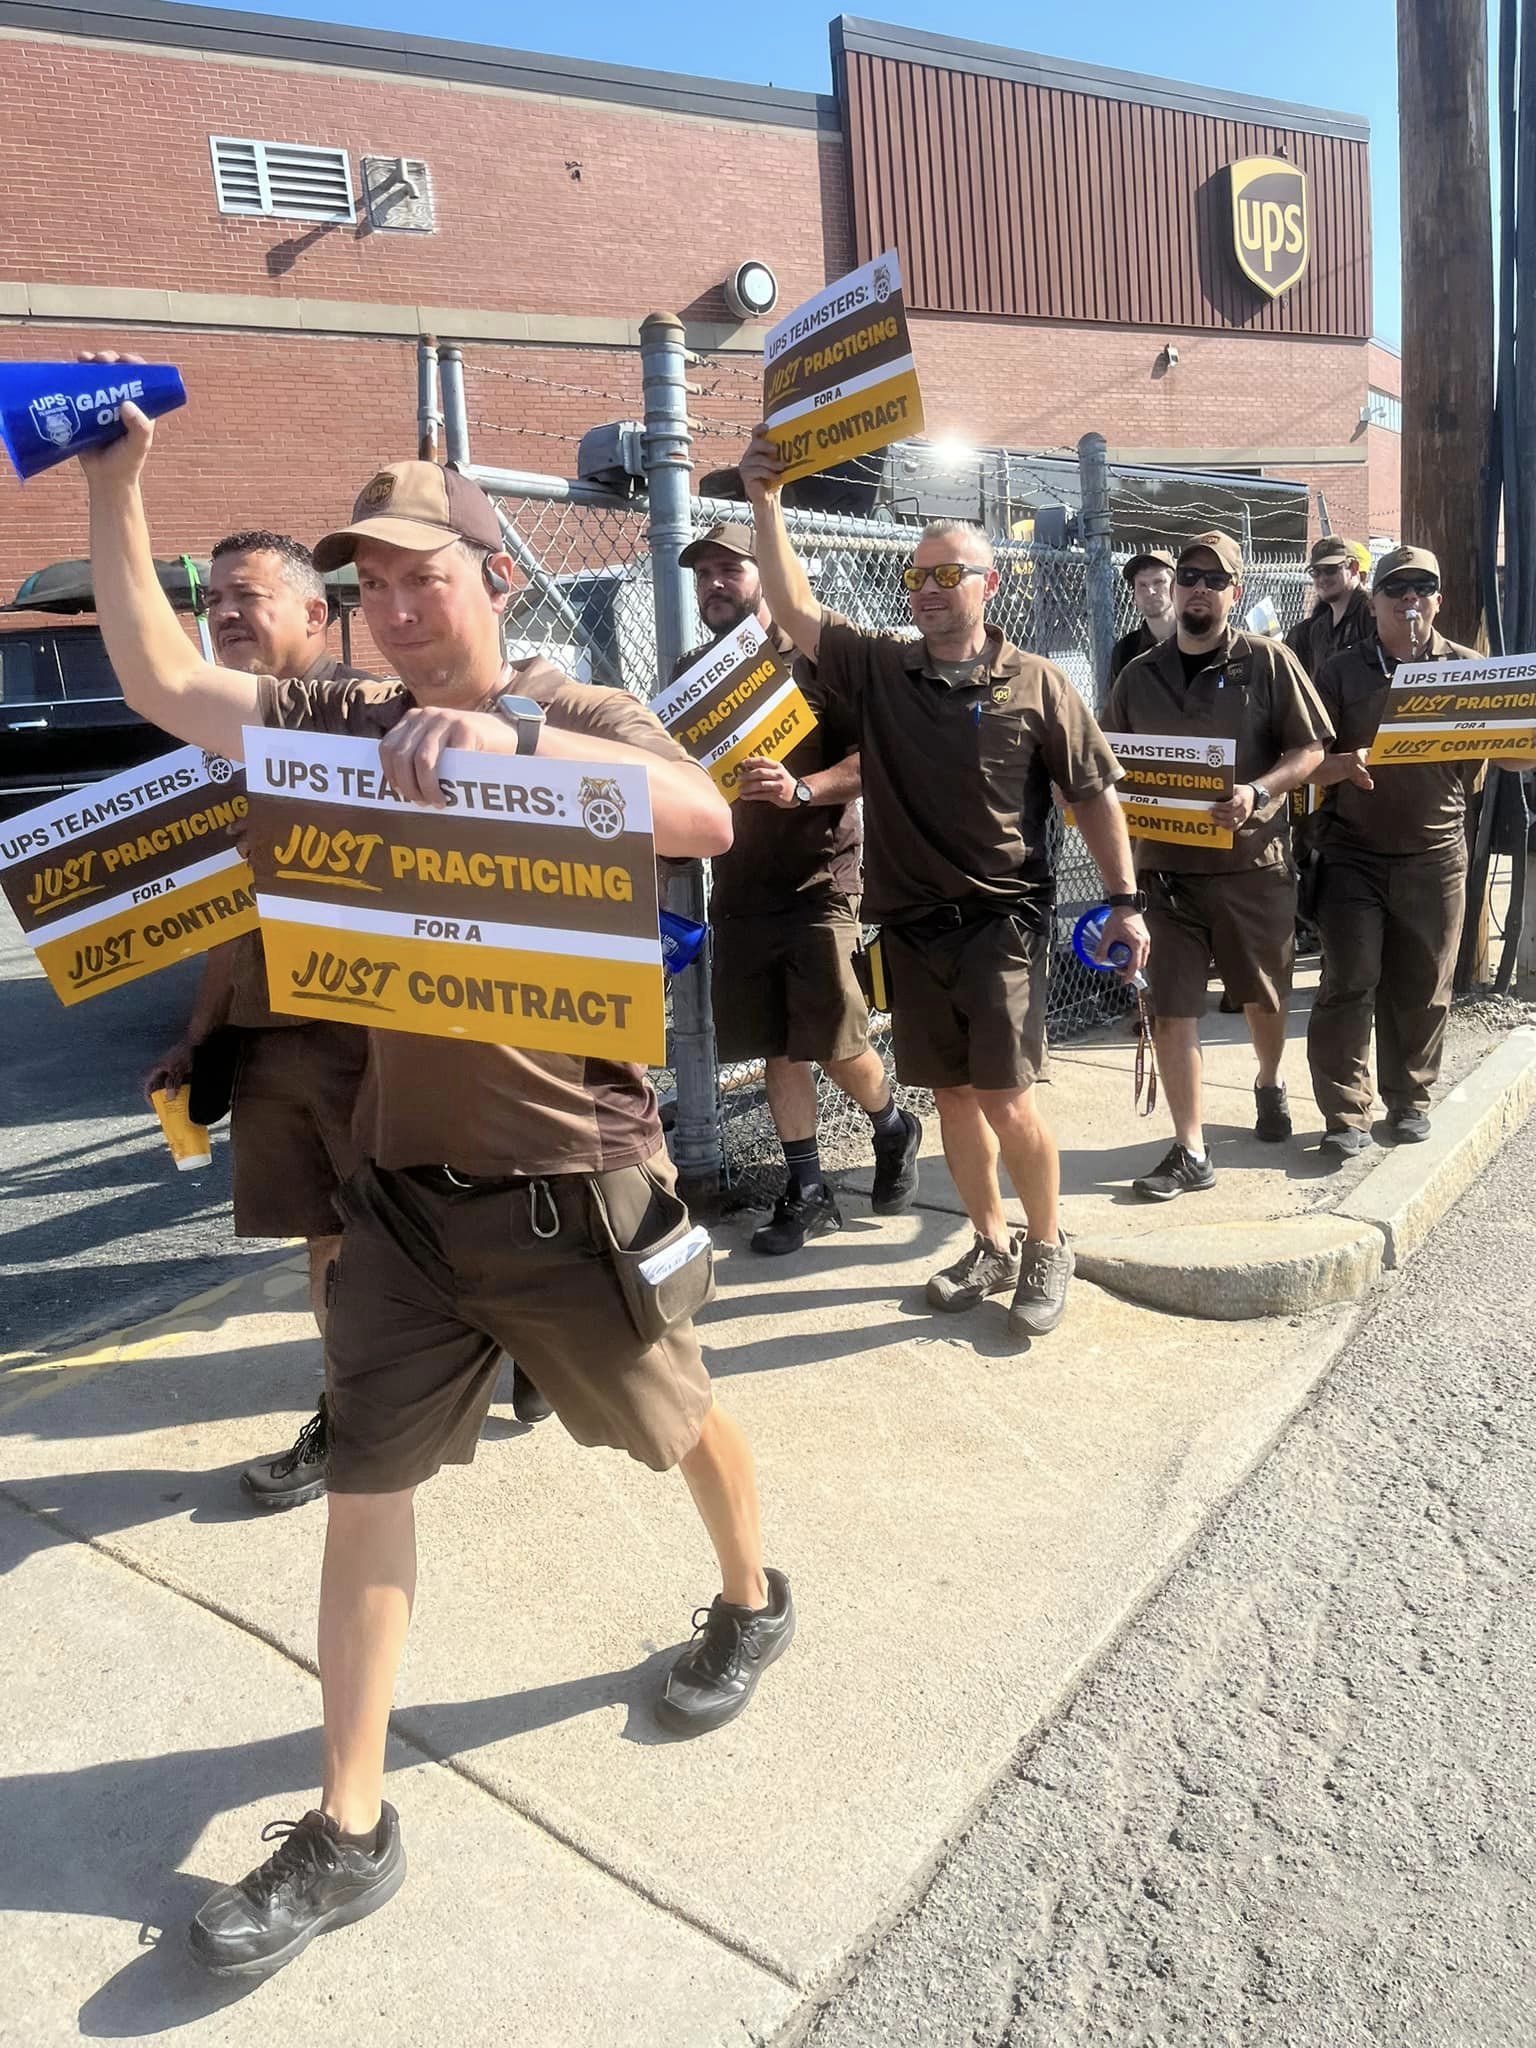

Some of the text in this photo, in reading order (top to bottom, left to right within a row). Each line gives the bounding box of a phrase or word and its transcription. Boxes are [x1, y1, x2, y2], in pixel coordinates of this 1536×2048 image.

[1240, 199, 1303, 272] ups
[769, 286, 869, 359] UPS TEAMSTERS:
[768, 316, 898, 398] JUST PRACTICING
[33, 393, 66, 412] UPS
[76, 381, 144, 411] GAME
[814, 387, 842, 408] FOR A
[816, 395, 908, 448] CONTRACT
[657, 651, 739, 722] EAMSTERS:
[686, 660, 777, 744] PRACTICING
[1397, 692, 1536, 713] JUST PRACTICI
[1403, 672, 1437, 685] UPS
[711, 734, 740, 760] FOR A
[1110, 743, 1200, 760] EAMSTERS:
[1384, 739, 1440, 754] JUST
[1, 768, 199, 860] UPS TEAMSTERS:
[265, 758, 567, 818] UPS TEASTERS:
[1130, 795, 1150, 804] FOR
[27, 795, 249, 905] JUST PRACTICING
[273, 825, 633, 902] JUST PRACTICING
[132, 877, 176, 904] FOR A
[68, 883, 257, 980] JUST CONTRA
[413, 918, 482, 942] FOR A
[291, 951, 632, 1029] JUST CONTRACT
